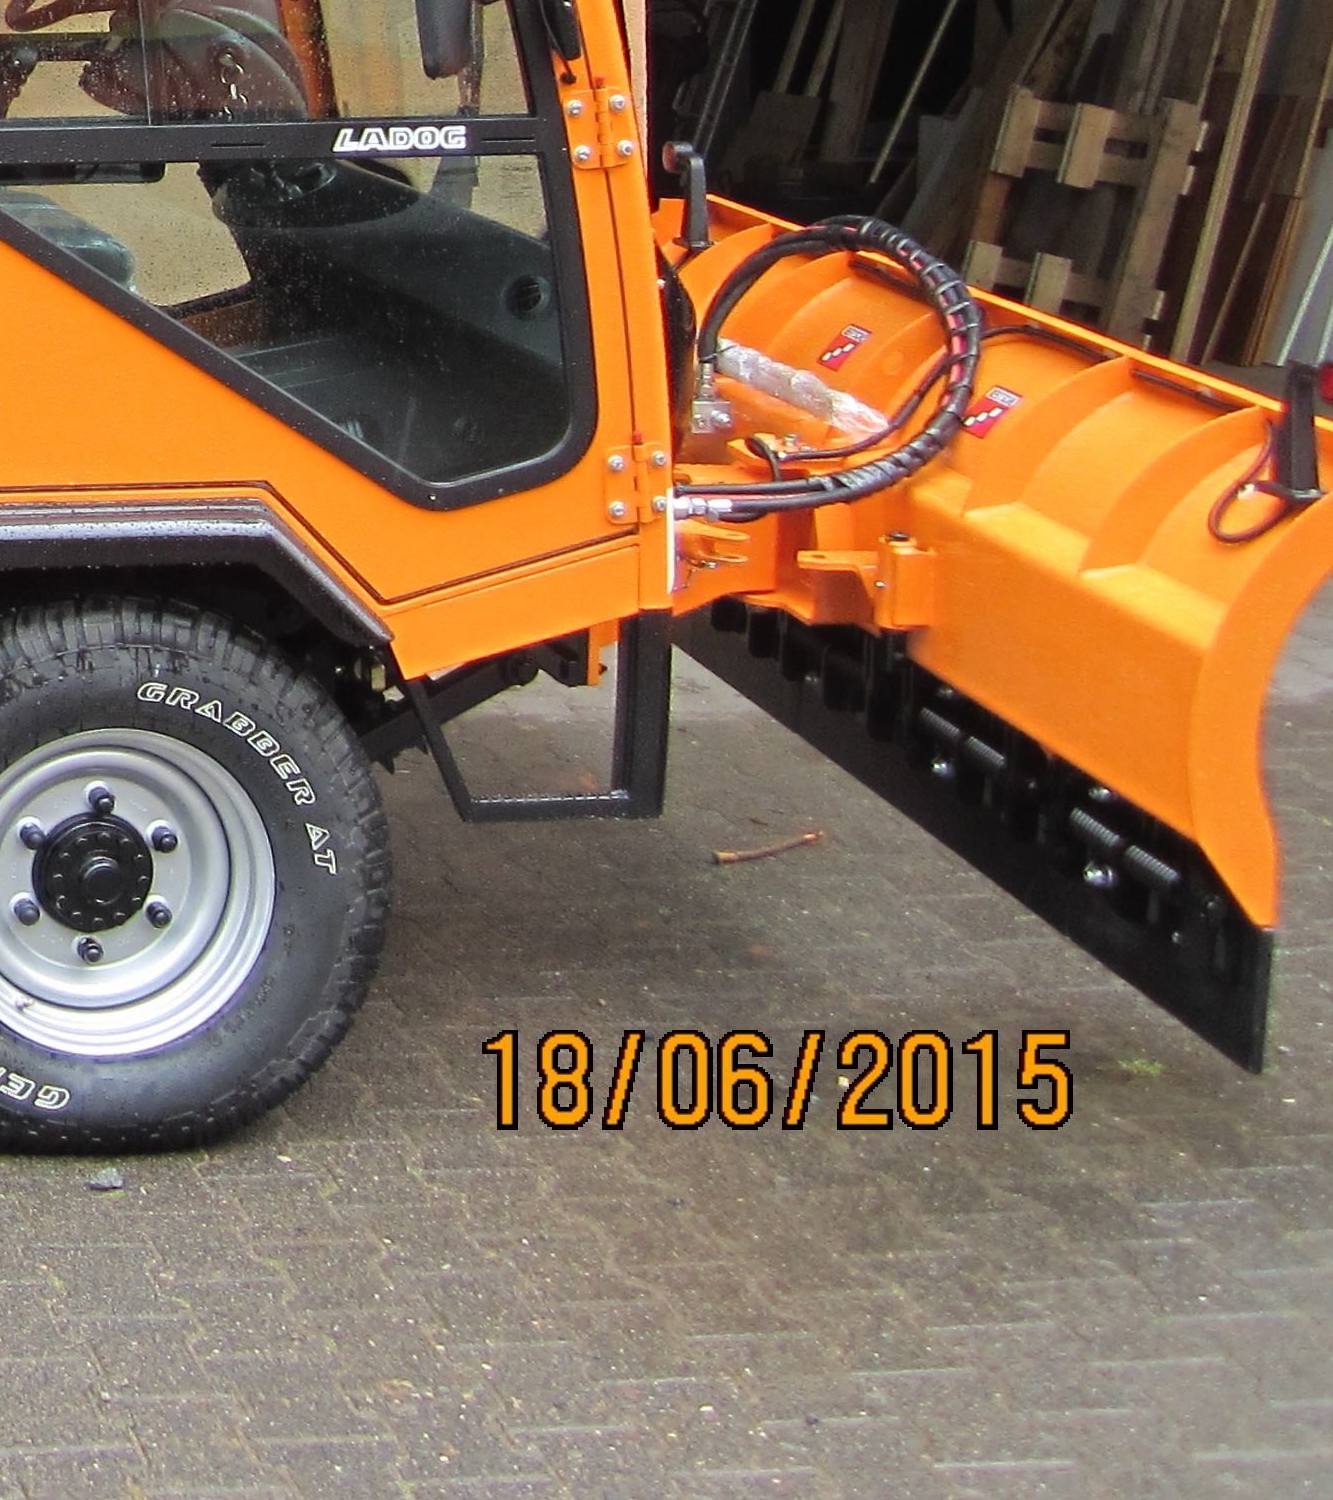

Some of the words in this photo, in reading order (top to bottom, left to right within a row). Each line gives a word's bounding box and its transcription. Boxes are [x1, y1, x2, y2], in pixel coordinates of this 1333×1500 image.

[332, 125, 467, 152] LADOG
[137, 682, 317, 806] GRABBER
[305, 822, 338, 875] AT
